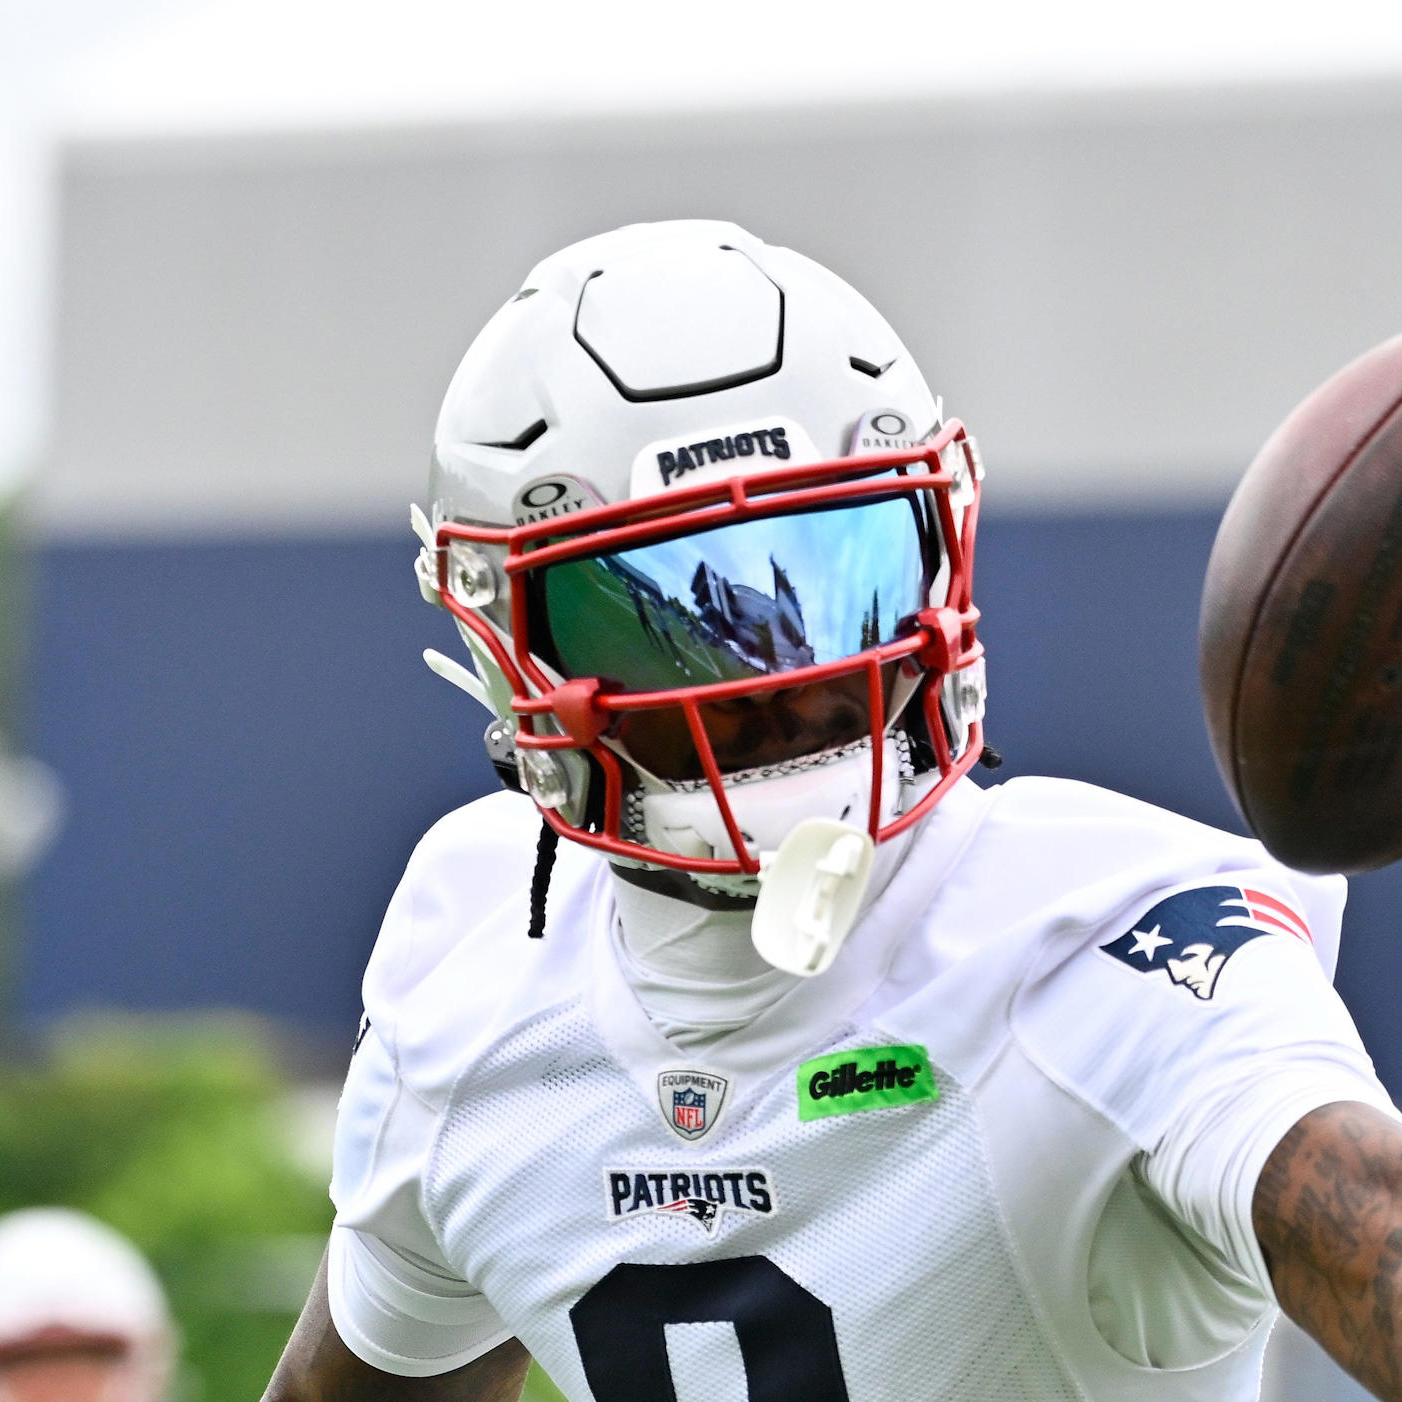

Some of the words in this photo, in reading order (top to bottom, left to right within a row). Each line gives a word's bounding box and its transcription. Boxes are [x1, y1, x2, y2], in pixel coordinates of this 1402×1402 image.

[657, 427, 790, 486] PATRIOTS
[662, 1075, 722, 1091] EQUIPMENT
[809, 1060, 915, 1100] Gillette
[676, 1107, 702, 1128] NFL
[609, 1172, 772, 1215] PATRIOTS
